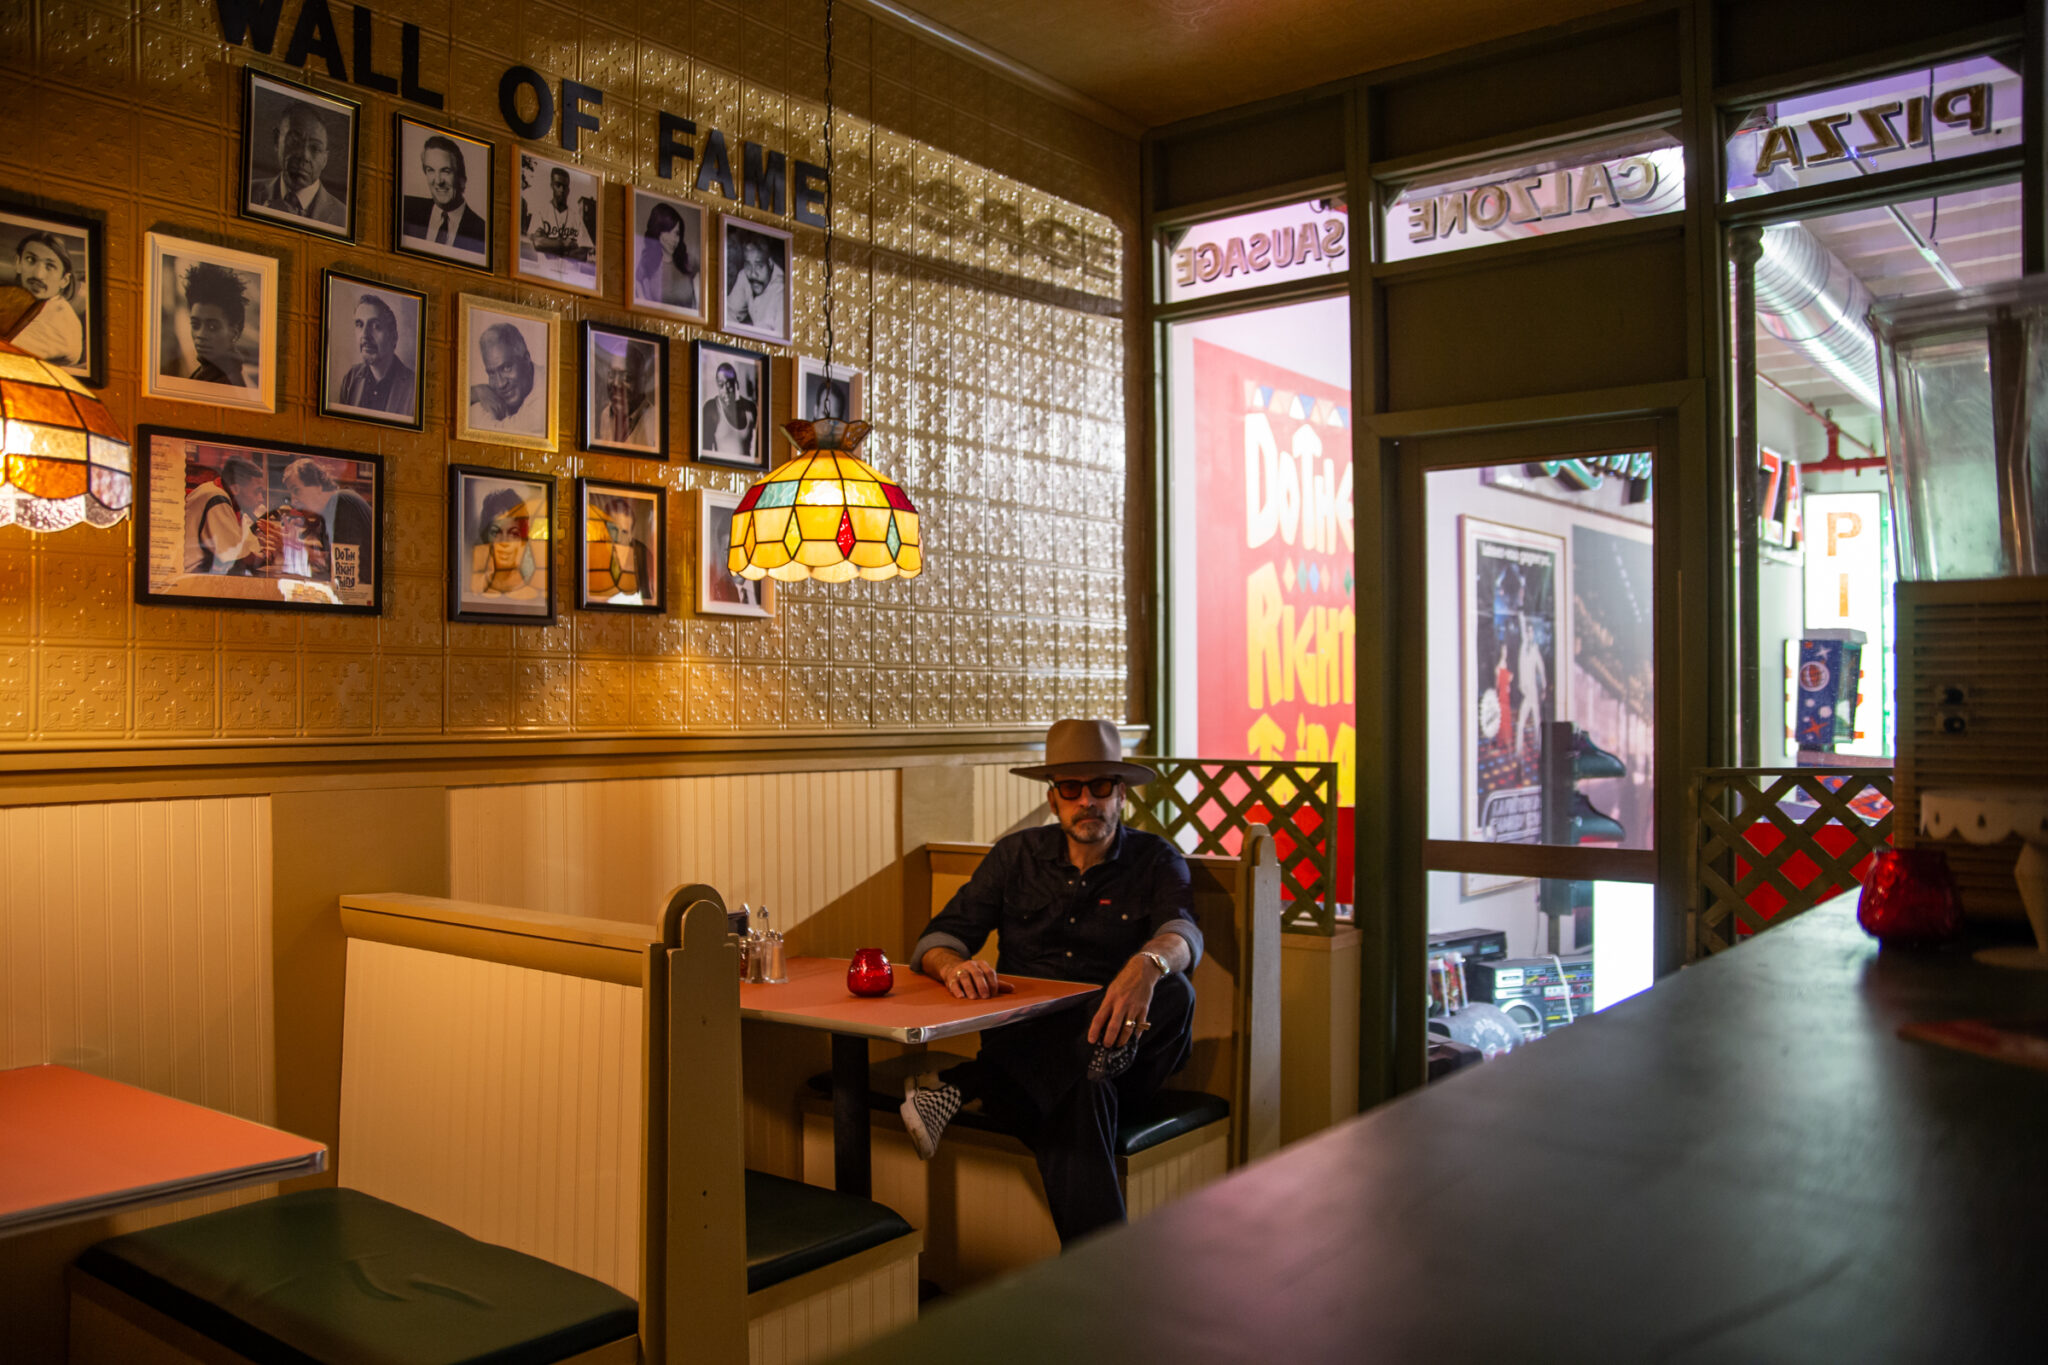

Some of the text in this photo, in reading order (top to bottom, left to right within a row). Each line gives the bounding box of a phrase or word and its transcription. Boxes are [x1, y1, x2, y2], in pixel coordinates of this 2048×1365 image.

[214, 0, 829, 228] WALL OF FAME
